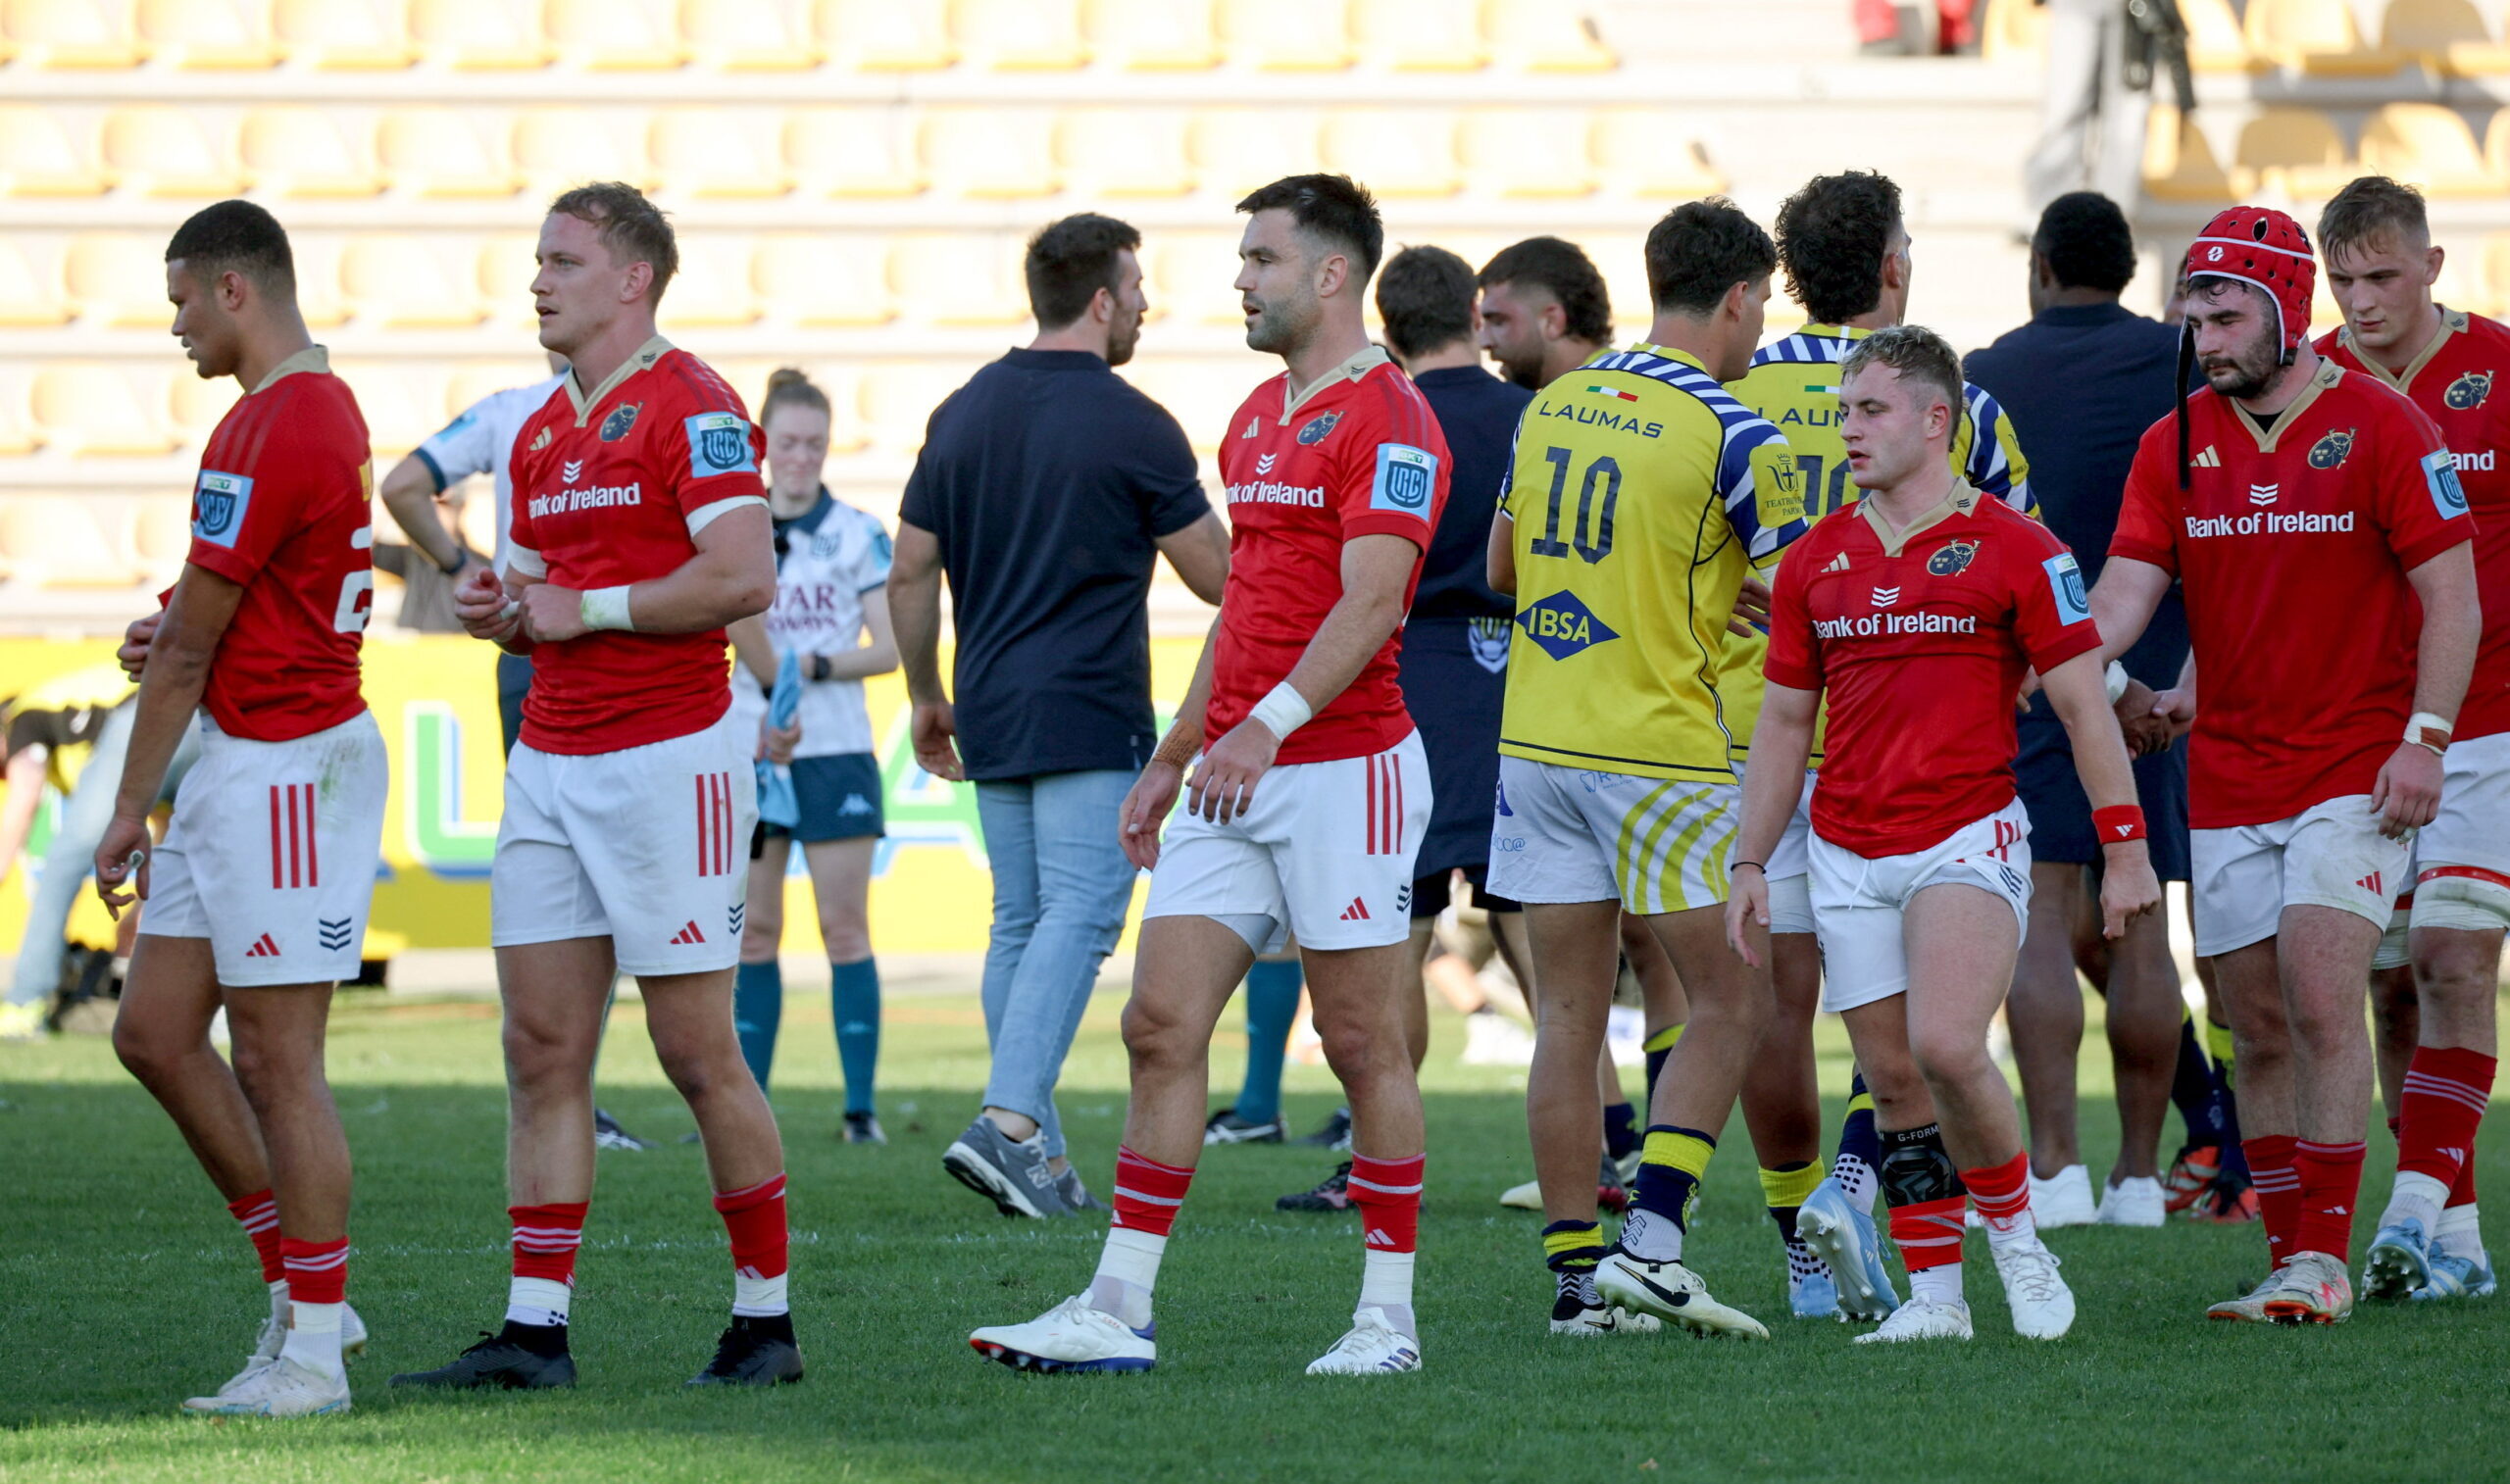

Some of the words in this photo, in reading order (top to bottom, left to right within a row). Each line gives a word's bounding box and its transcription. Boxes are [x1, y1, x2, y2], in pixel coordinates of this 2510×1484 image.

[1538, 400, 1664, 439] LAUMAS
[1758, 407, 1843, 427] LAU
[2450, 449, 2495, 471] and
[551, 489, 570, 515] of
[570, 481, 641, 512] Ireland
[1240, 480, 1260, 503] of
[1256, 480, 1325, 508] Ireland
[1531, 445, 1623, 566] 10
[2185, 514, 2234, 538] Bank
[2236, 512, 2264, 535] of
[2267, 511, 2354, 534] Ireland
[1529, 607, 1591, 645] IBSA
[1812, 616, 1855, 639] Bank
[1856, 613, 1883, 636] of
[1886, 611, 1976, 634] Ireland
